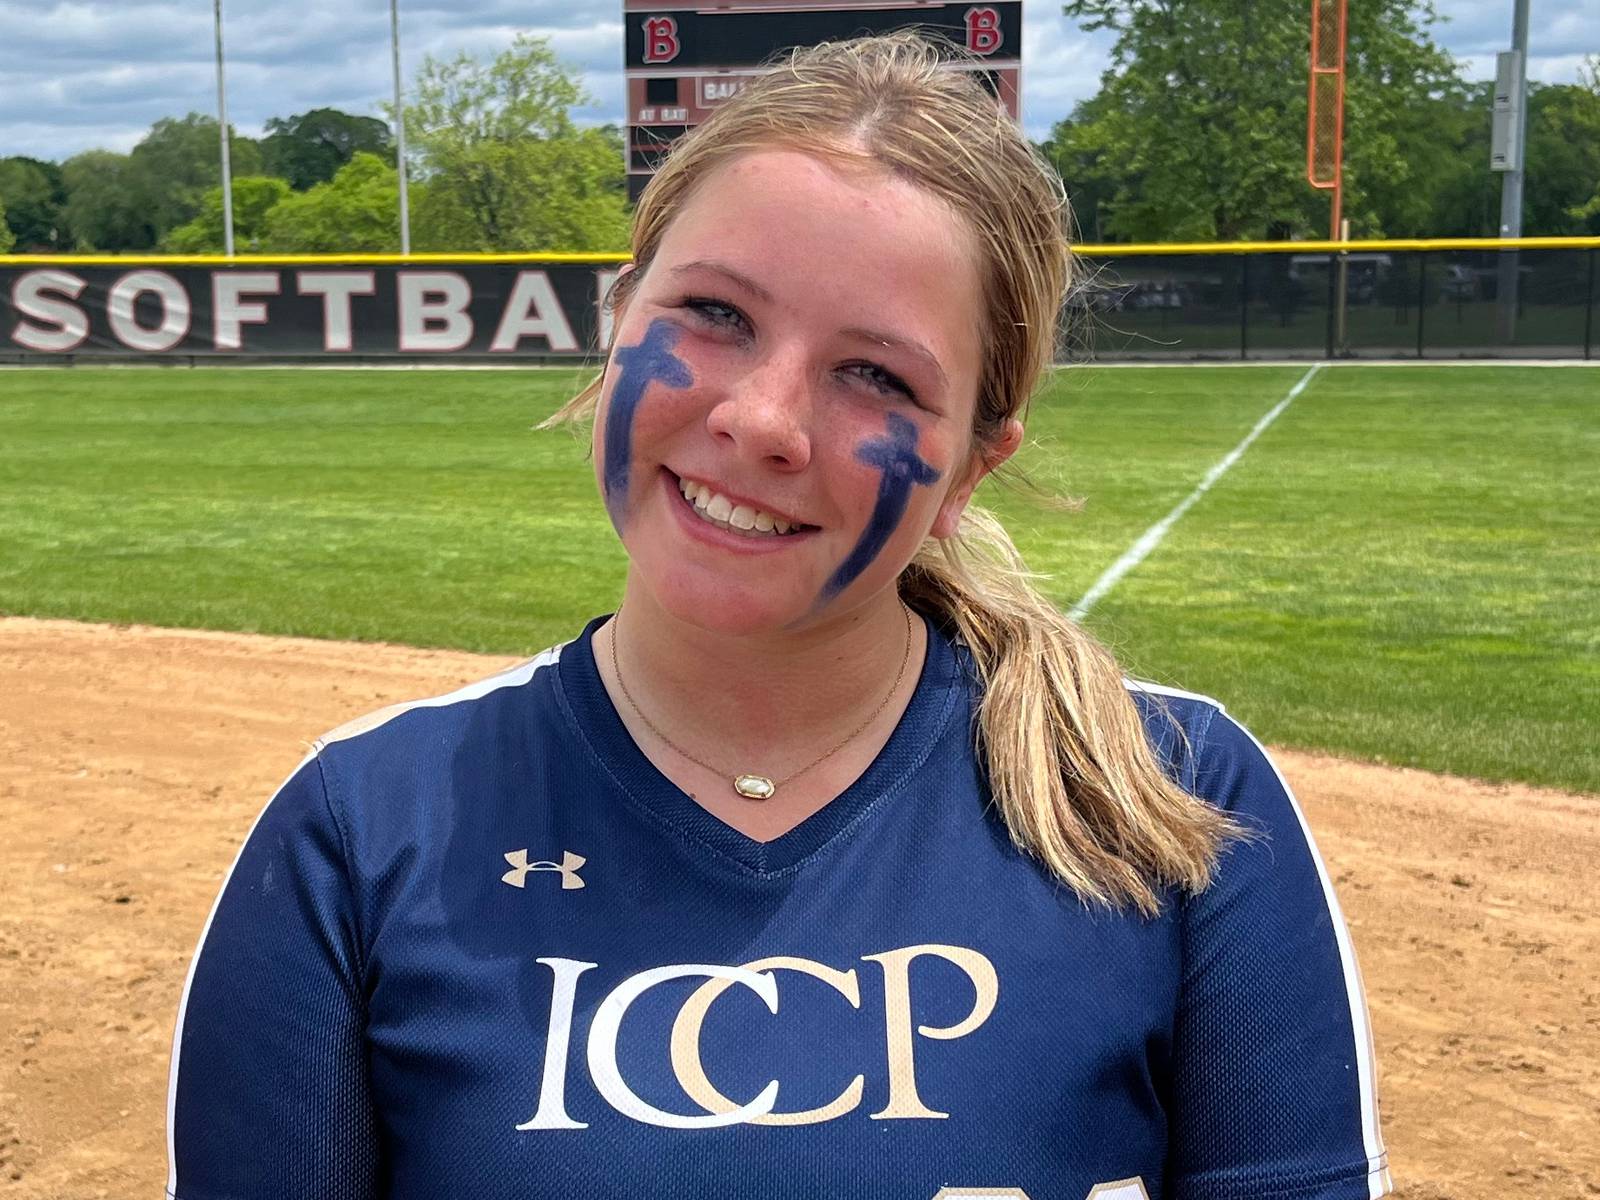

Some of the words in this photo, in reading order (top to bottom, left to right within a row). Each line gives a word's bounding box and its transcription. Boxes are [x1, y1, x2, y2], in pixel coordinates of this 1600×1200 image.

[642, 16, 680, 63] B
[964, 7, 1003, 55] B
[515, 943, 999, 1132] ICCP
